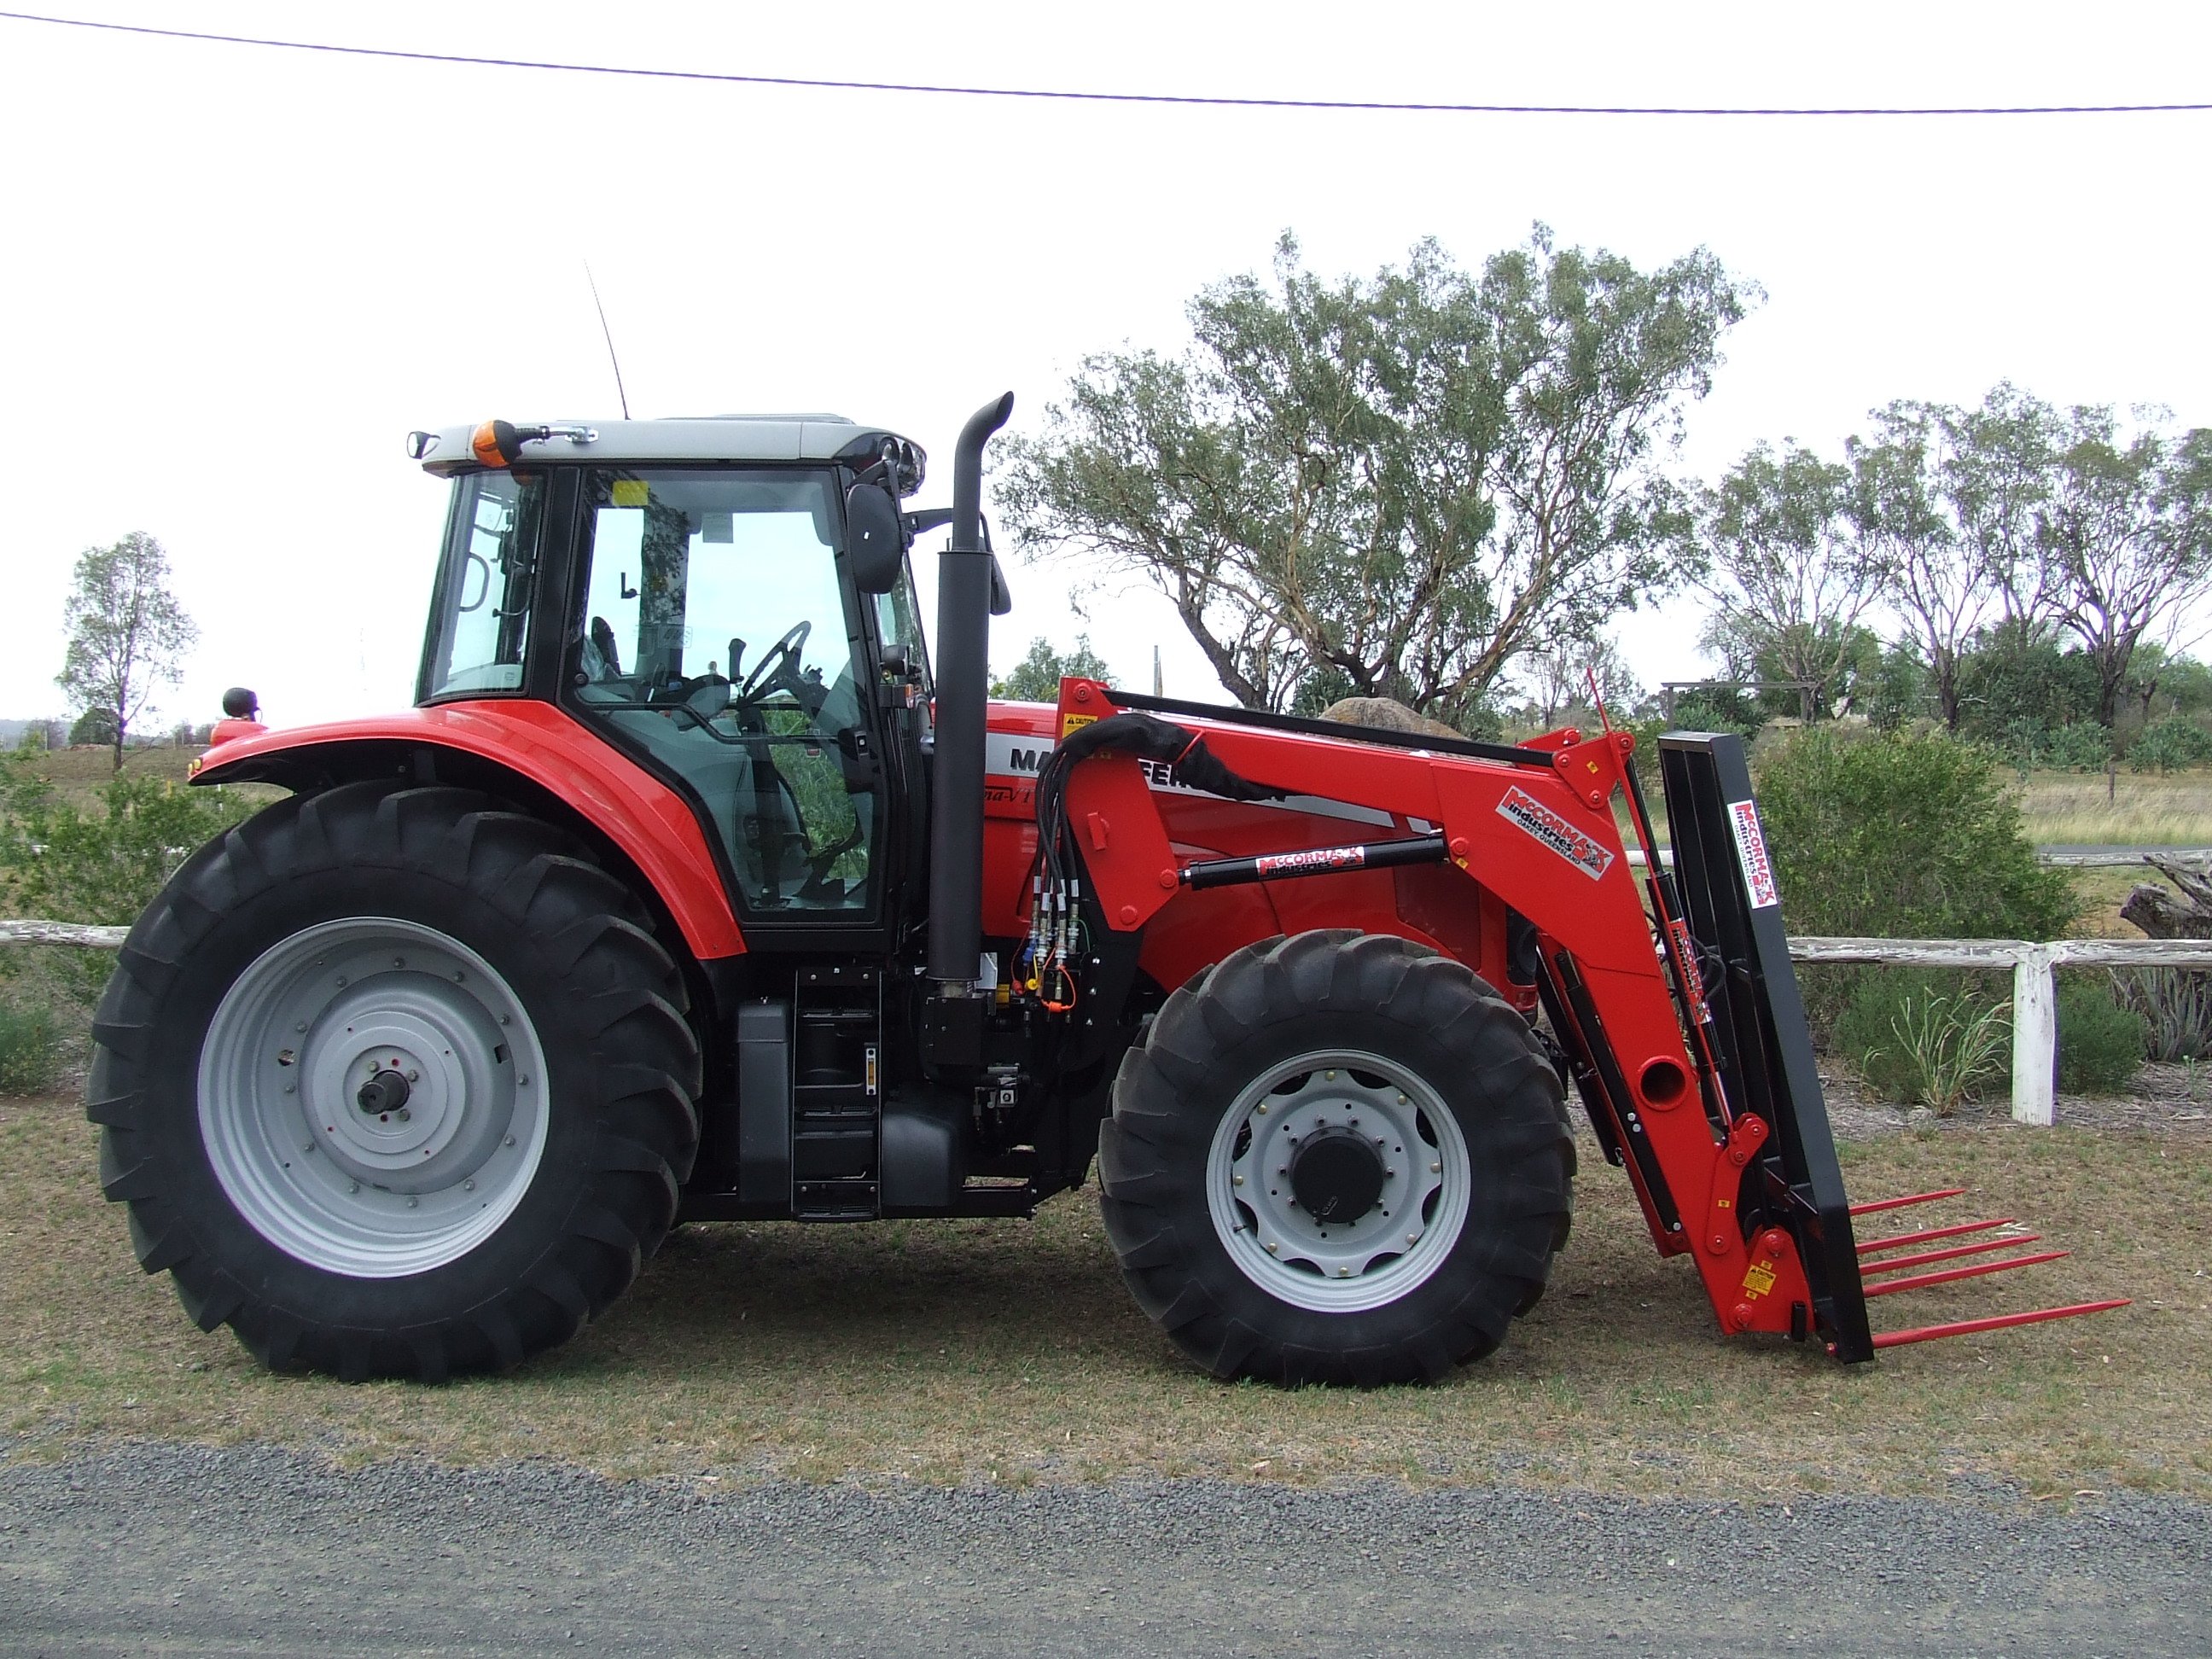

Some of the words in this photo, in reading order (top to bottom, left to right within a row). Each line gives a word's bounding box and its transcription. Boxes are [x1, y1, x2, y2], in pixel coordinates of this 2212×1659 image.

[1508, 803, 1575, 853] industries
[1539, 833, 1580, 865] QUEENSLAND
[1736, 811, 1757, 875] industries
